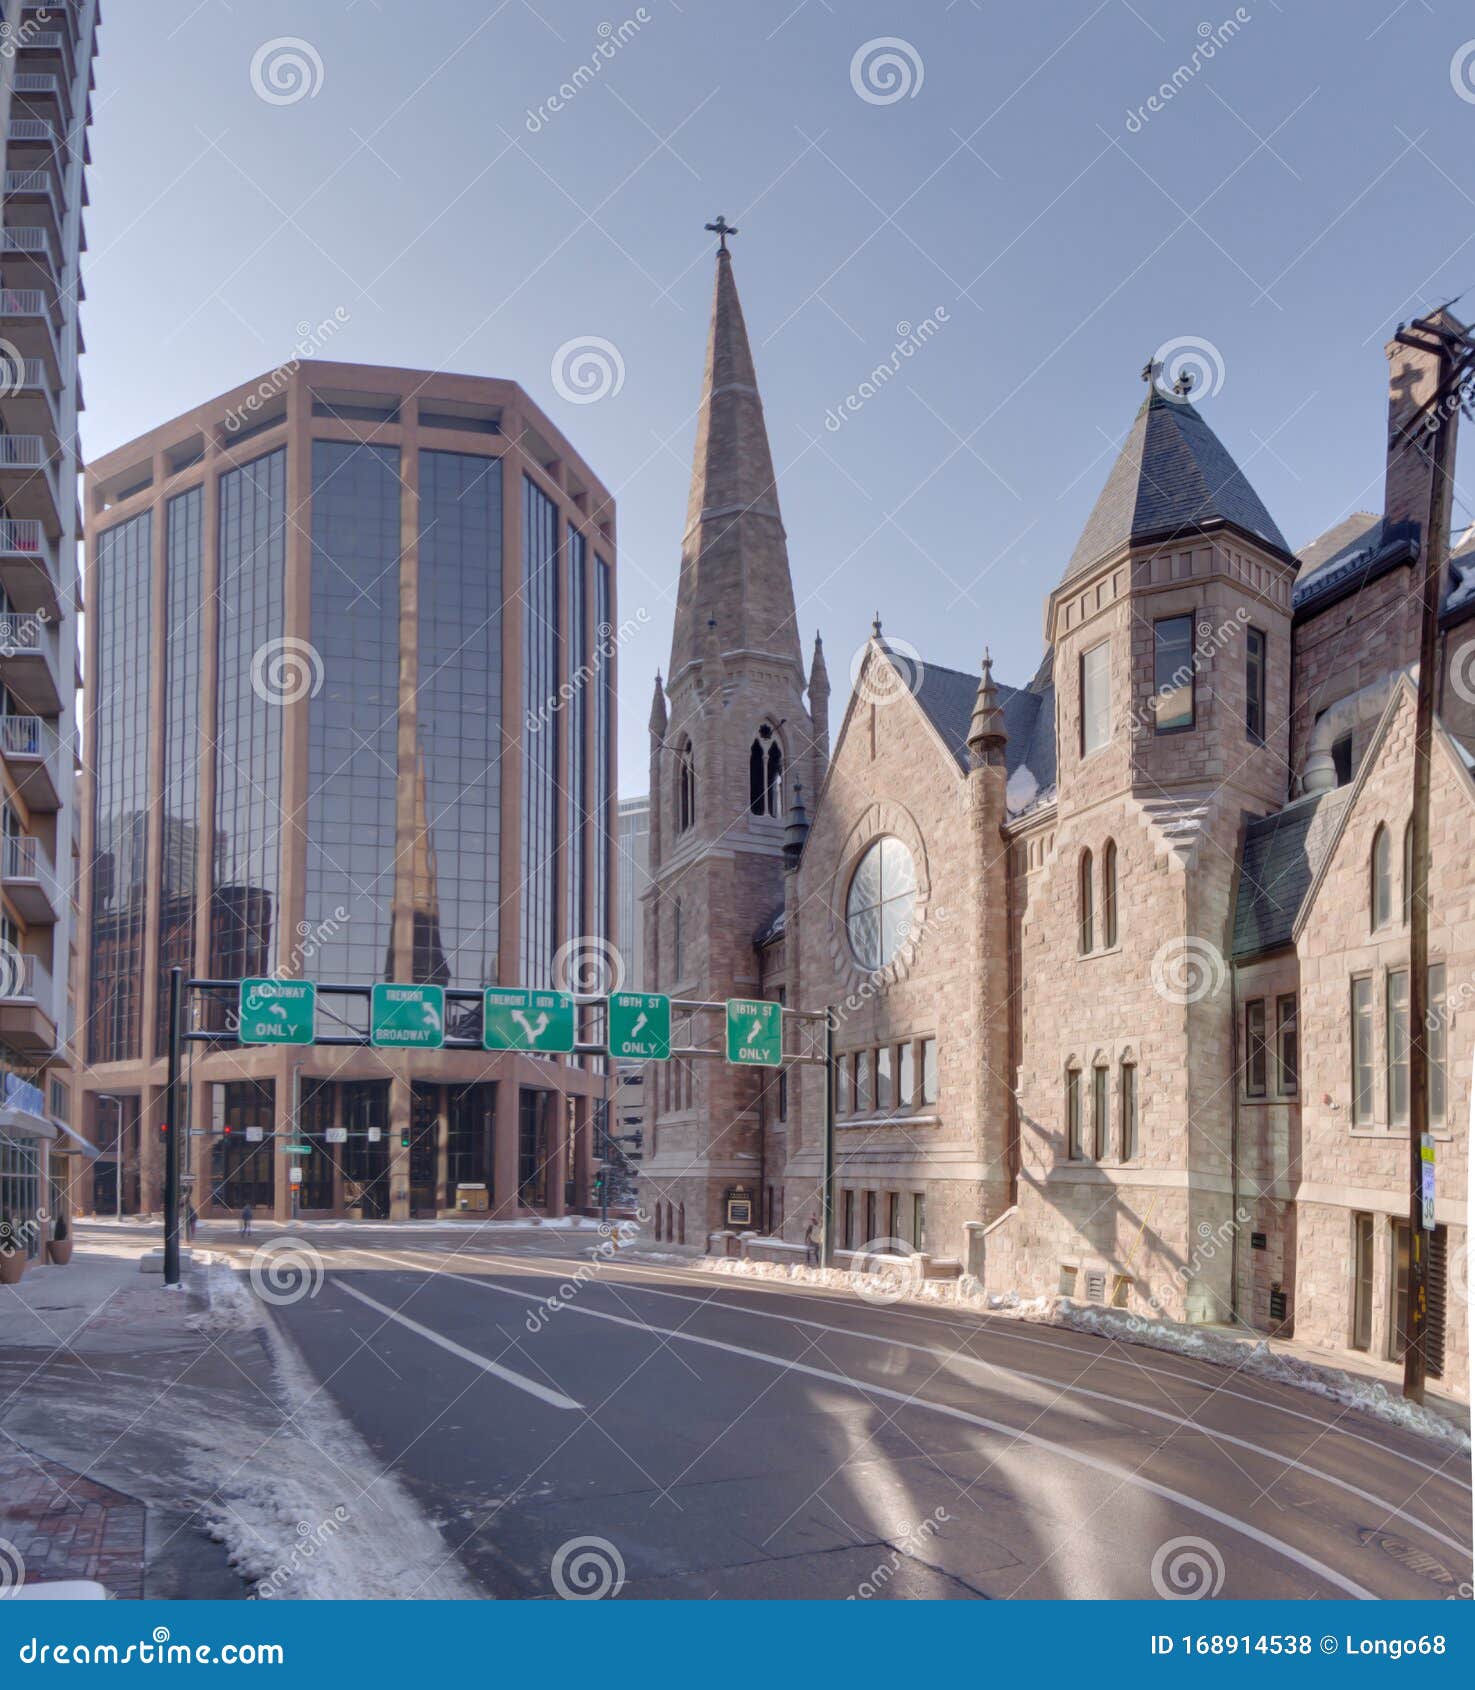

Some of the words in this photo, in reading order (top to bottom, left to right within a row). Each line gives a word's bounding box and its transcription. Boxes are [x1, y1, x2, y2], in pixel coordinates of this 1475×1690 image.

[250, 986, 306, 998] BROADWAY
[618, 997, 642, 1008] 18TH
[648, 997, 661, 1009] ST
[761, 1005, 773, 1017] ST
[255, 1022, 298, 1037] ONLY
[376, 1029, 431, 1041] BROADWAY
[621, 1041, 658, 1055] ONLY
[738, 1047, 770, 1061] ONLY
[1424, 1196, 1434, 1218] 30
